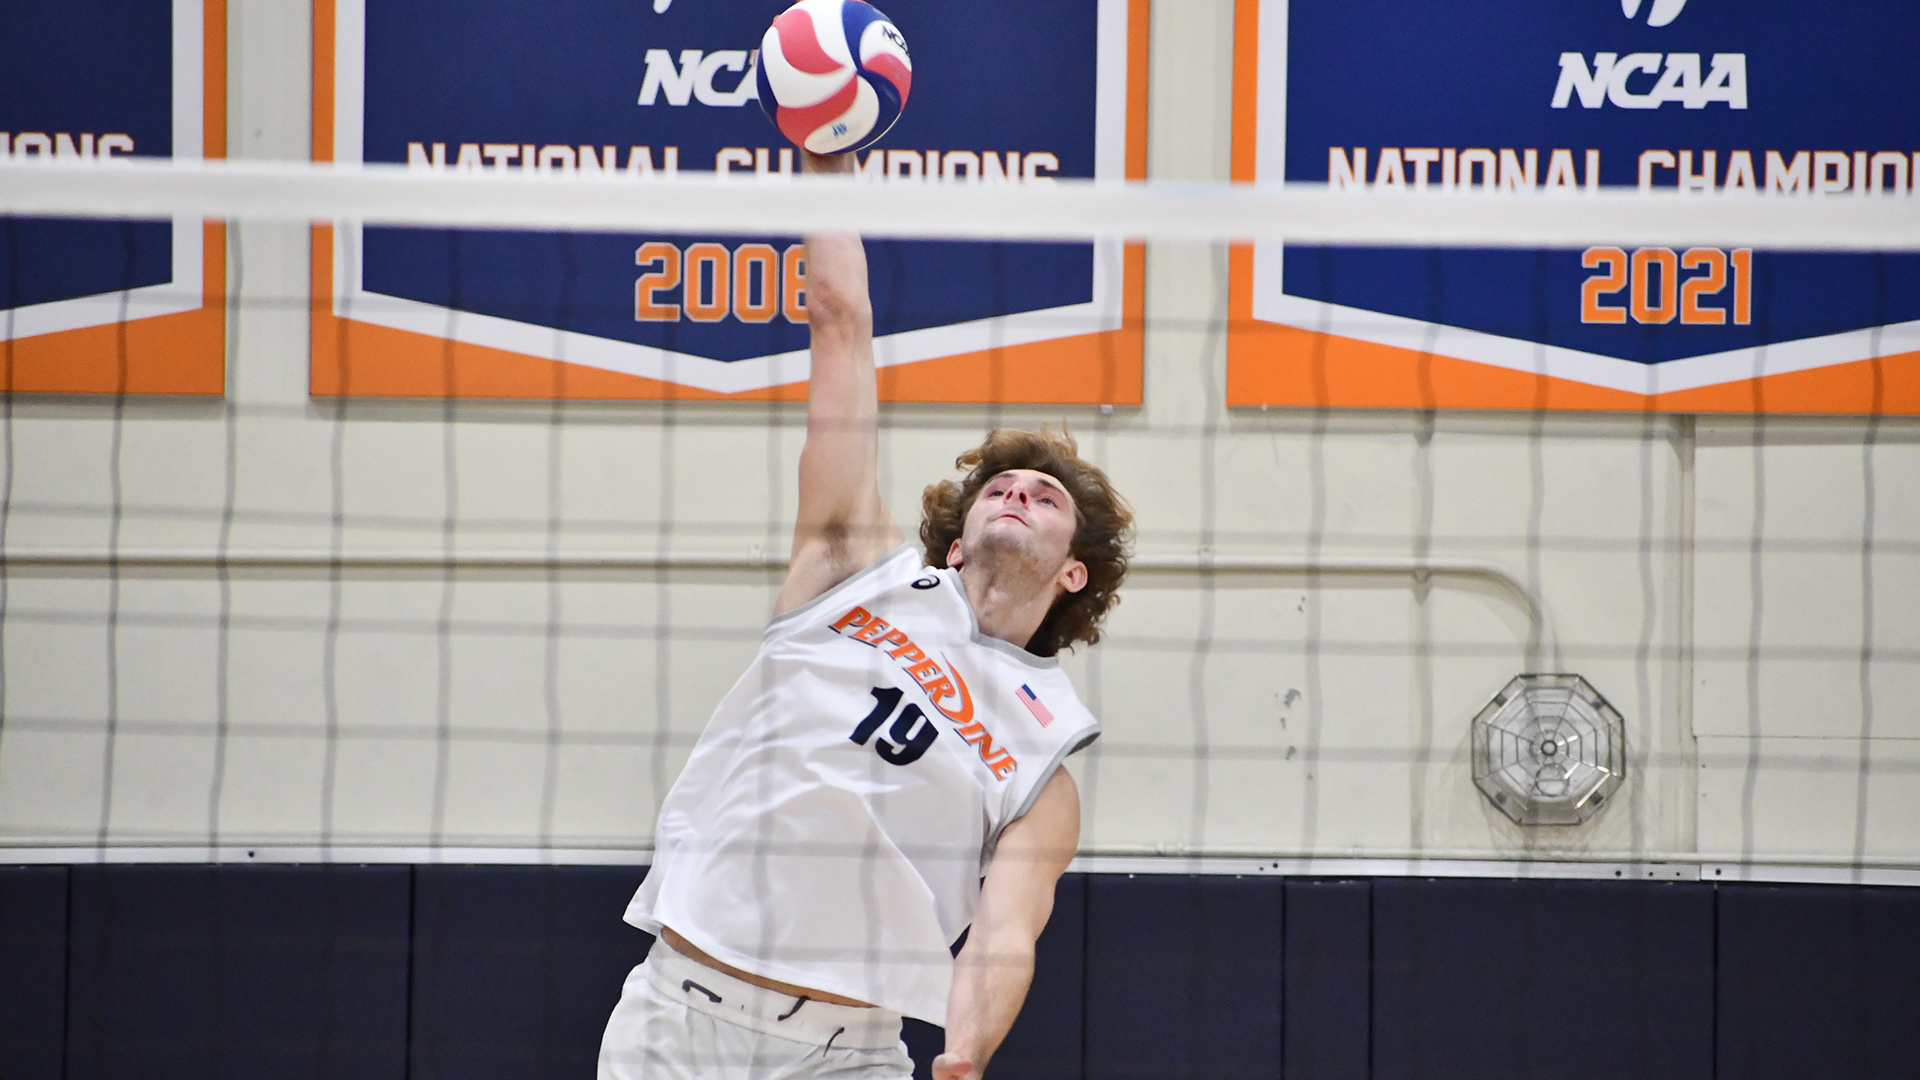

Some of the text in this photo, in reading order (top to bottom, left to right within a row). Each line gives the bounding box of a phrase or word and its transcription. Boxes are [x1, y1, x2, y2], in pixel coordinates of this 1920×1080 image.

[637, 49, 762, 107] NC
[1551, 52, 1748, 109] NCAA
[1638, 150, 1920, 192] CHAMPIO
[1581, 247, 1752, 325] 2021
[828, 605, 1018, 782] PEPPERDINE
[848, 686, 939, 766] 19
